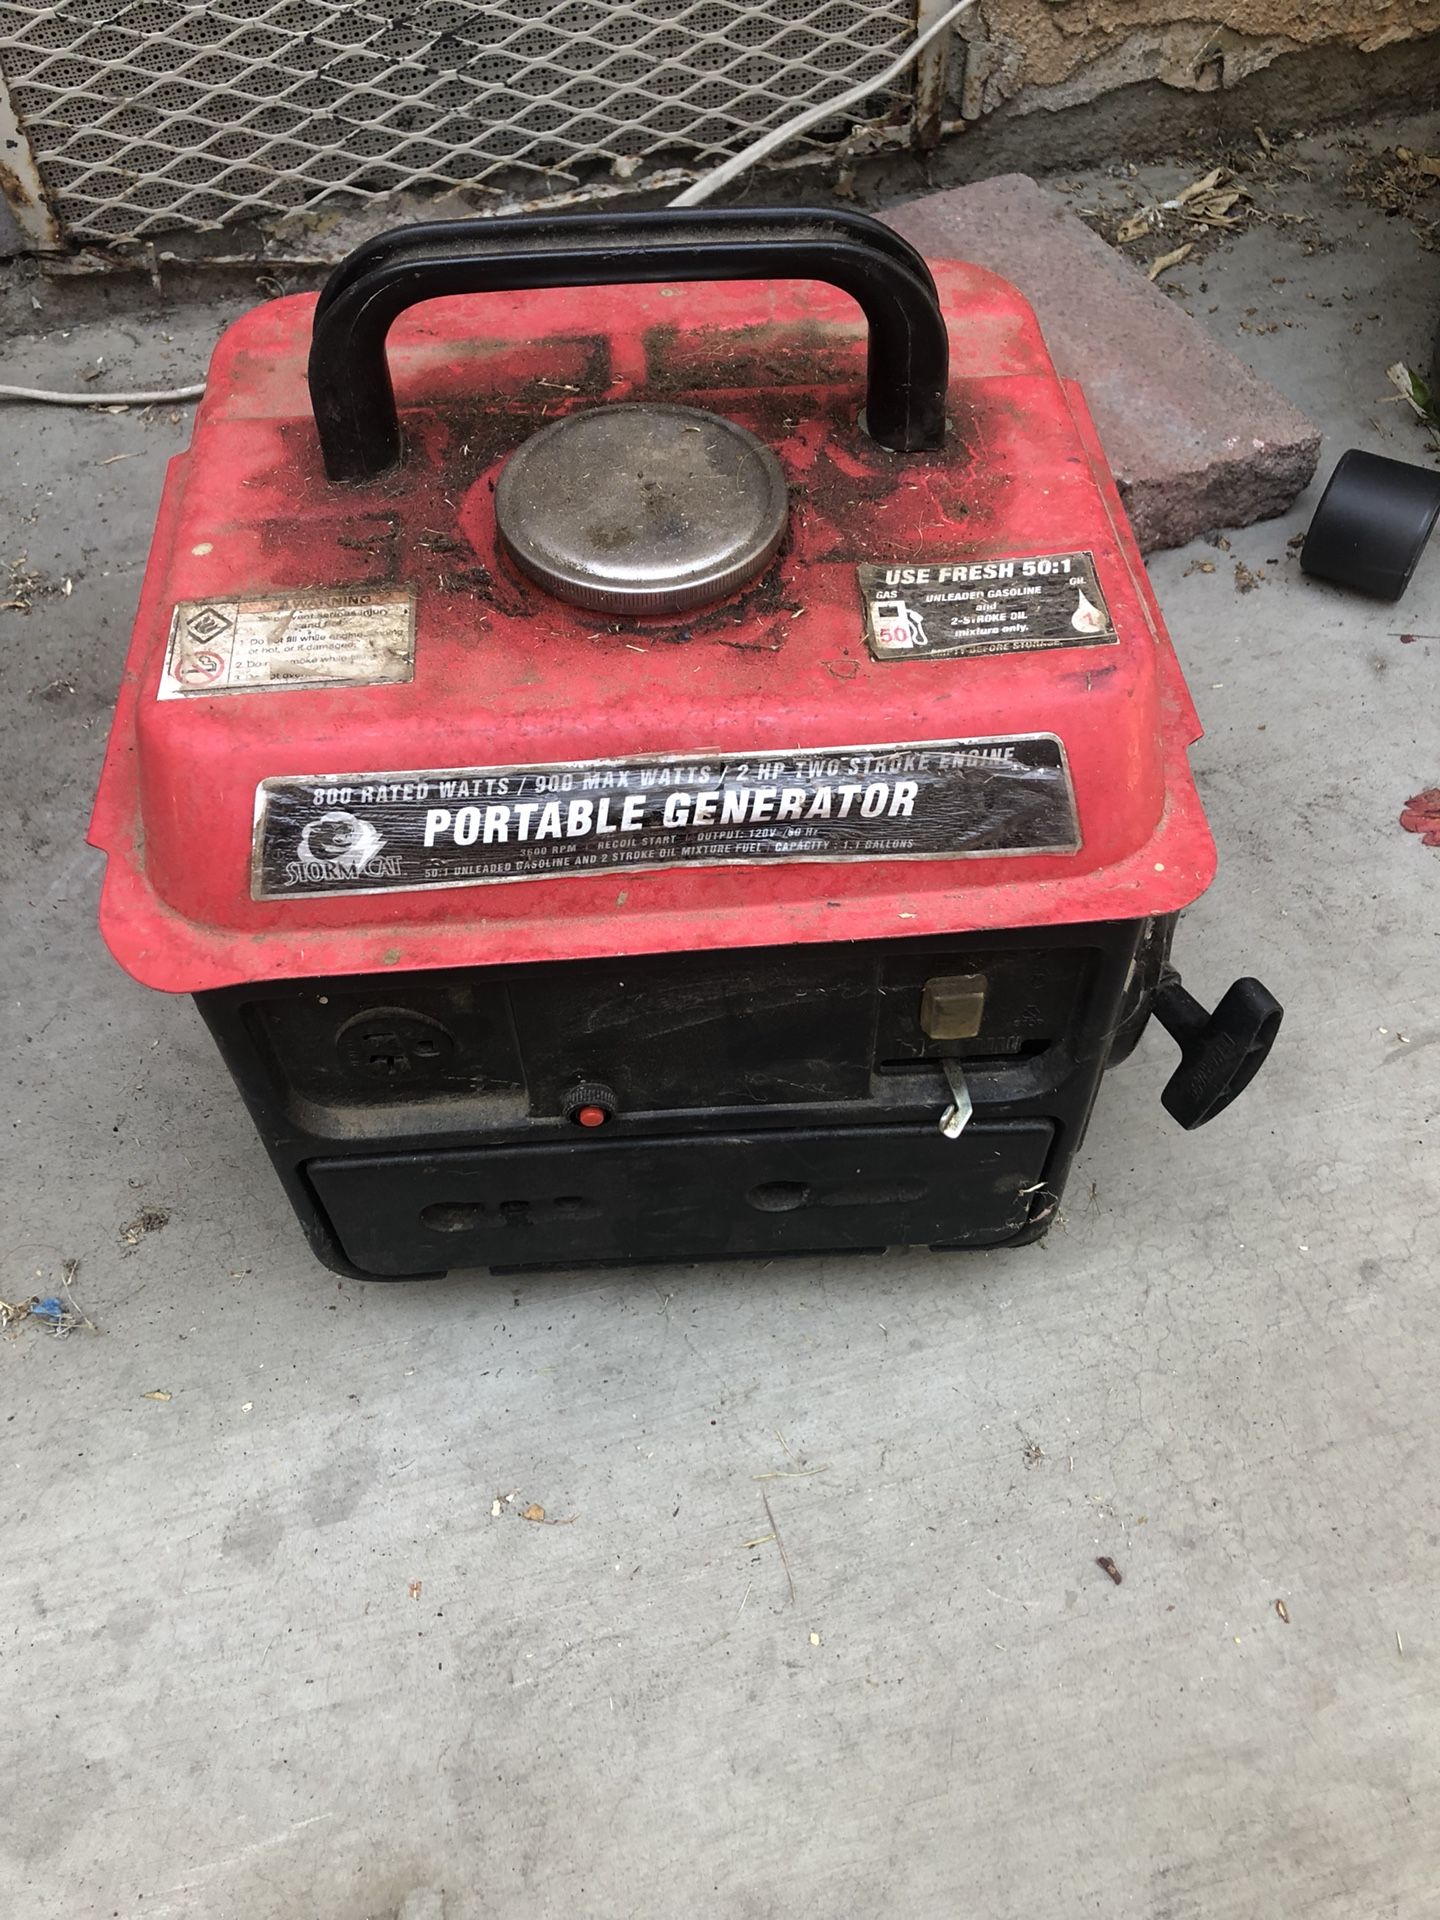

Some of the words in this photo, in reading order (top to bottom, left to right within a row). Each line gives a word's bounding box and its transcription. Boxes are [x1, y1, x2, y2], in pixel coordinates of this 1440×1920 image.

[885, 568, 931, 586] USE
[938, 562, 1014, 584] FRESH
[1022, 558, 1072, 577] 50:1
[875, 590, 898, 599] GAS
[925, 590, 985, 603] UNLEADED
[987, 585, 1043, 599] GASOLINE
[975, 601, 997, 612] and
[950, 612, 1007, 627] 2-STROKE
[1010, 611, 1028, 621] OIL
[879, 626, 908, 643] 50
[954, 626, 1000, 638] mixture
[313, 787, 353, 806] 800
[361, 782, 429, 804] RATED
[439, 777, 510, 799] WATTS
[517, 776, 527, 797] /
[535, 773, 573, 794] 900
[582, 770, 630, 791] MAX
[640, 765, 711, 786] WATTS
[718, 765, 729, 783] /
[736, 764, 749, 782] 2
[757, 762, 785, 781] HP
[796, 758, 841, 779] TWO
[848, 752, 931, 776] STROKE
[939, 747, 1016, 769] ENGINE
[424, 794, 647, 847] PORTABLE
[662, 780, 919, 829] GENERATOR
[552, 844, 577, 855] RPM
[598, 839, 637, 850] RECOIL
[641, 834, 677, 846] START
[697, 829, 745, 842] OUTPUT:
[749, 828, 777, 839] 120V
[424, 868, 449, 879] 50:1
[454, 862, 512, 877] UNLEADED
[515, 855, 571, 871] GASOLINE
[574, 854, 597, 866] AND
[601, 853, 608, 864] 2
[612, 849, 658, 862] STROKE
[659, 847, 676, 858] OIL
[681, 843, 731, 856] MIXTURE
[735, 841, 762, 853] FUEL
[775, 839, 830, 852] CAPACITY
[865, 838, 914, 850] GALLONS
[284, 859, 359, 887] STORM
[363, 855, 403, 878] CAT
